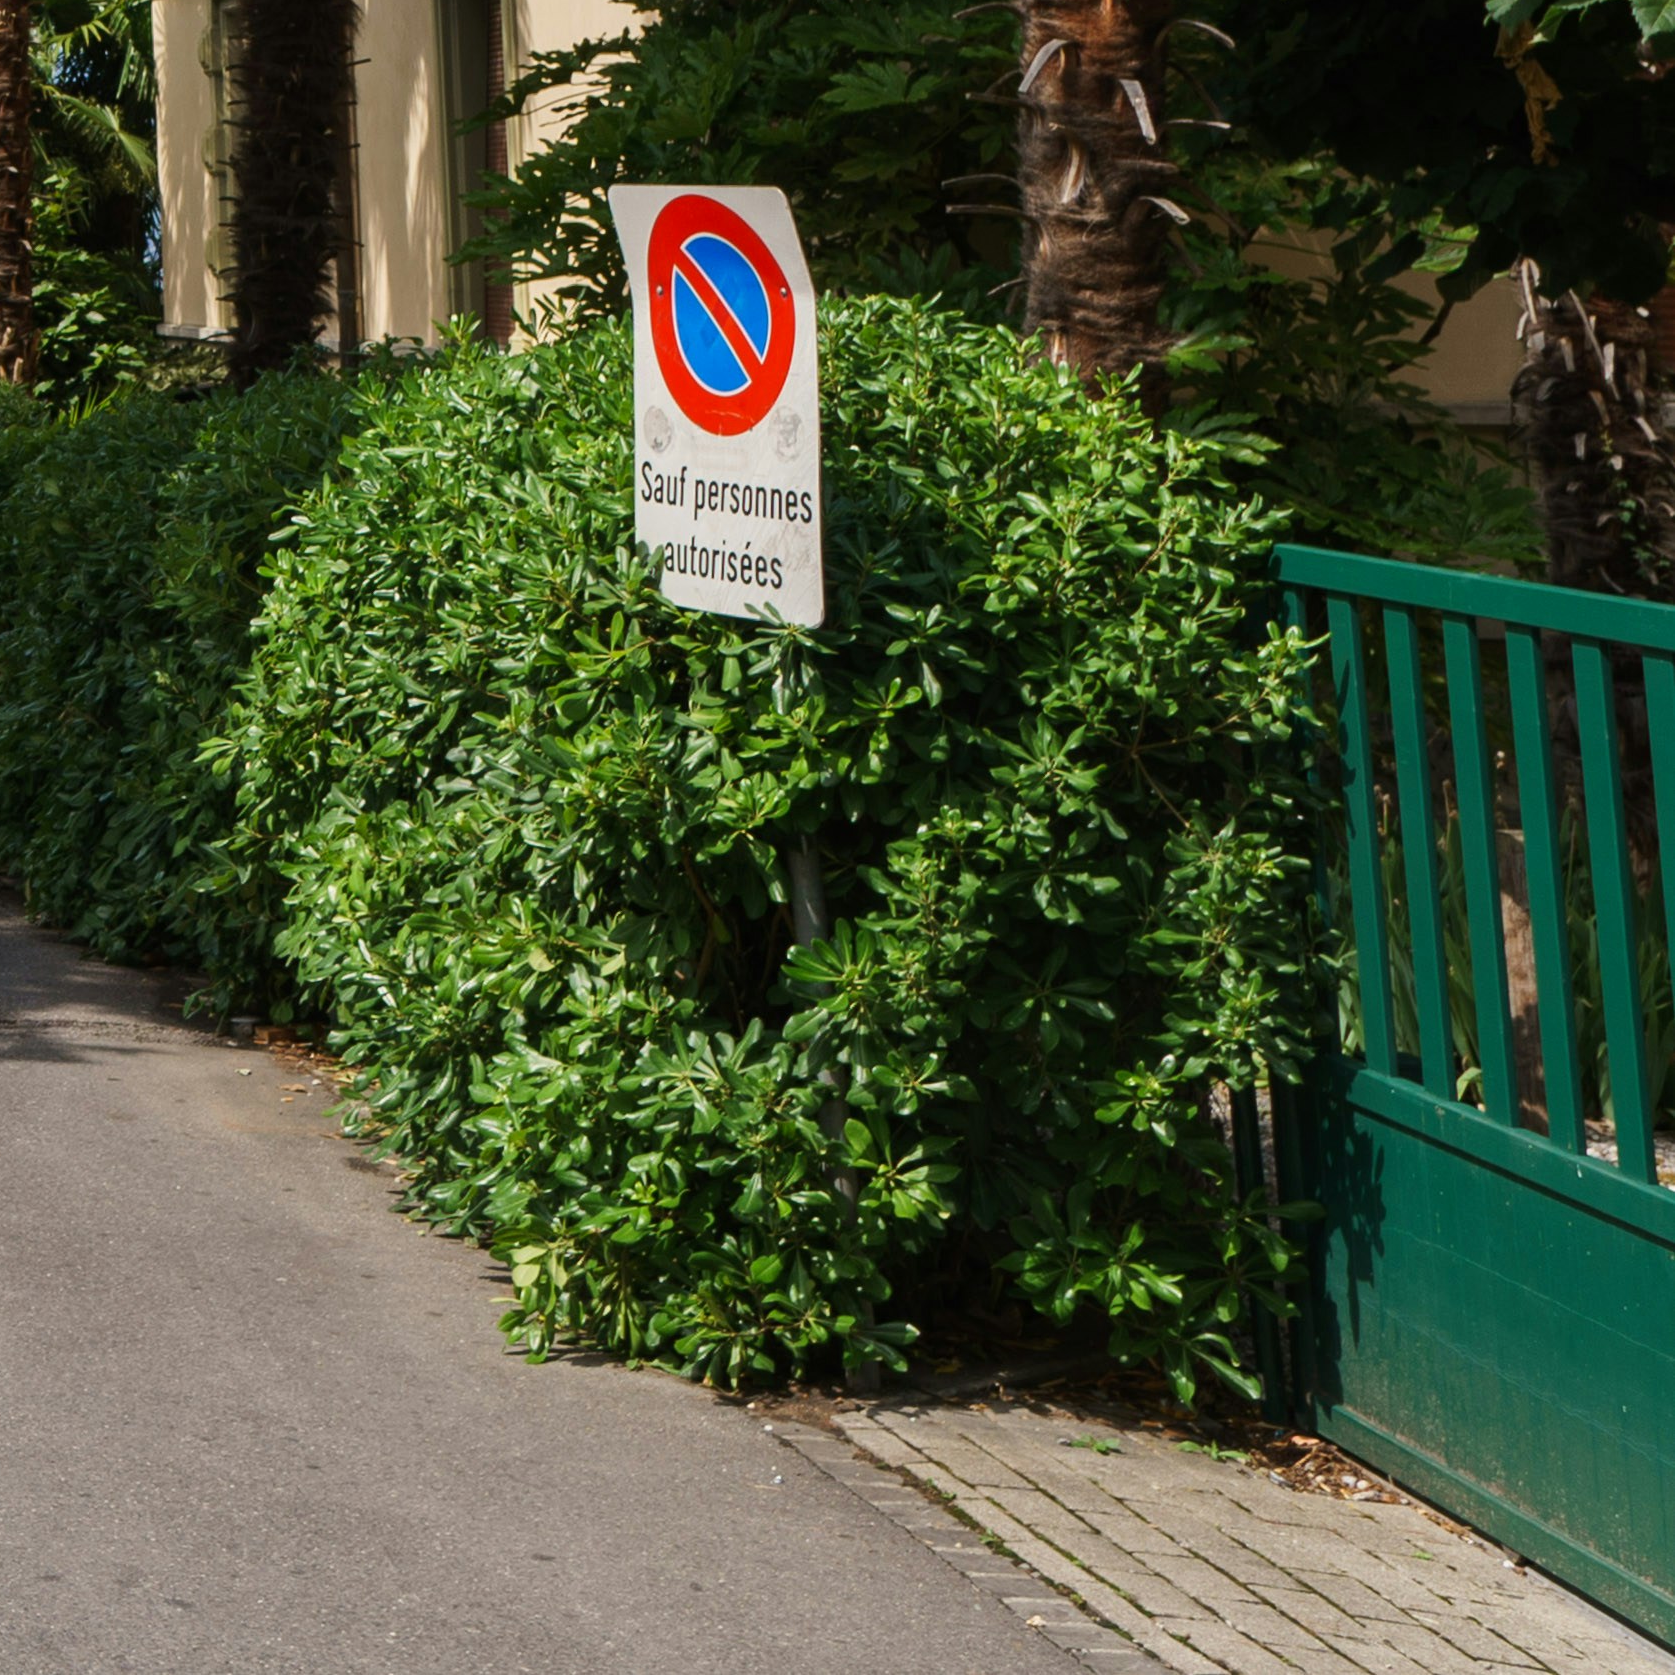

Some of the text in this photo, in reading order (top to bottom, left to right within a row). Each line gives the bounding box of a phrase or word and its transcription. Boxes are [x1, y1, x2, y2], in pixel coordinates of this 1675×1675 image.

[641, 461, 812, 524] Sauf personnes
[664, 535, 783, 590] autorisées
